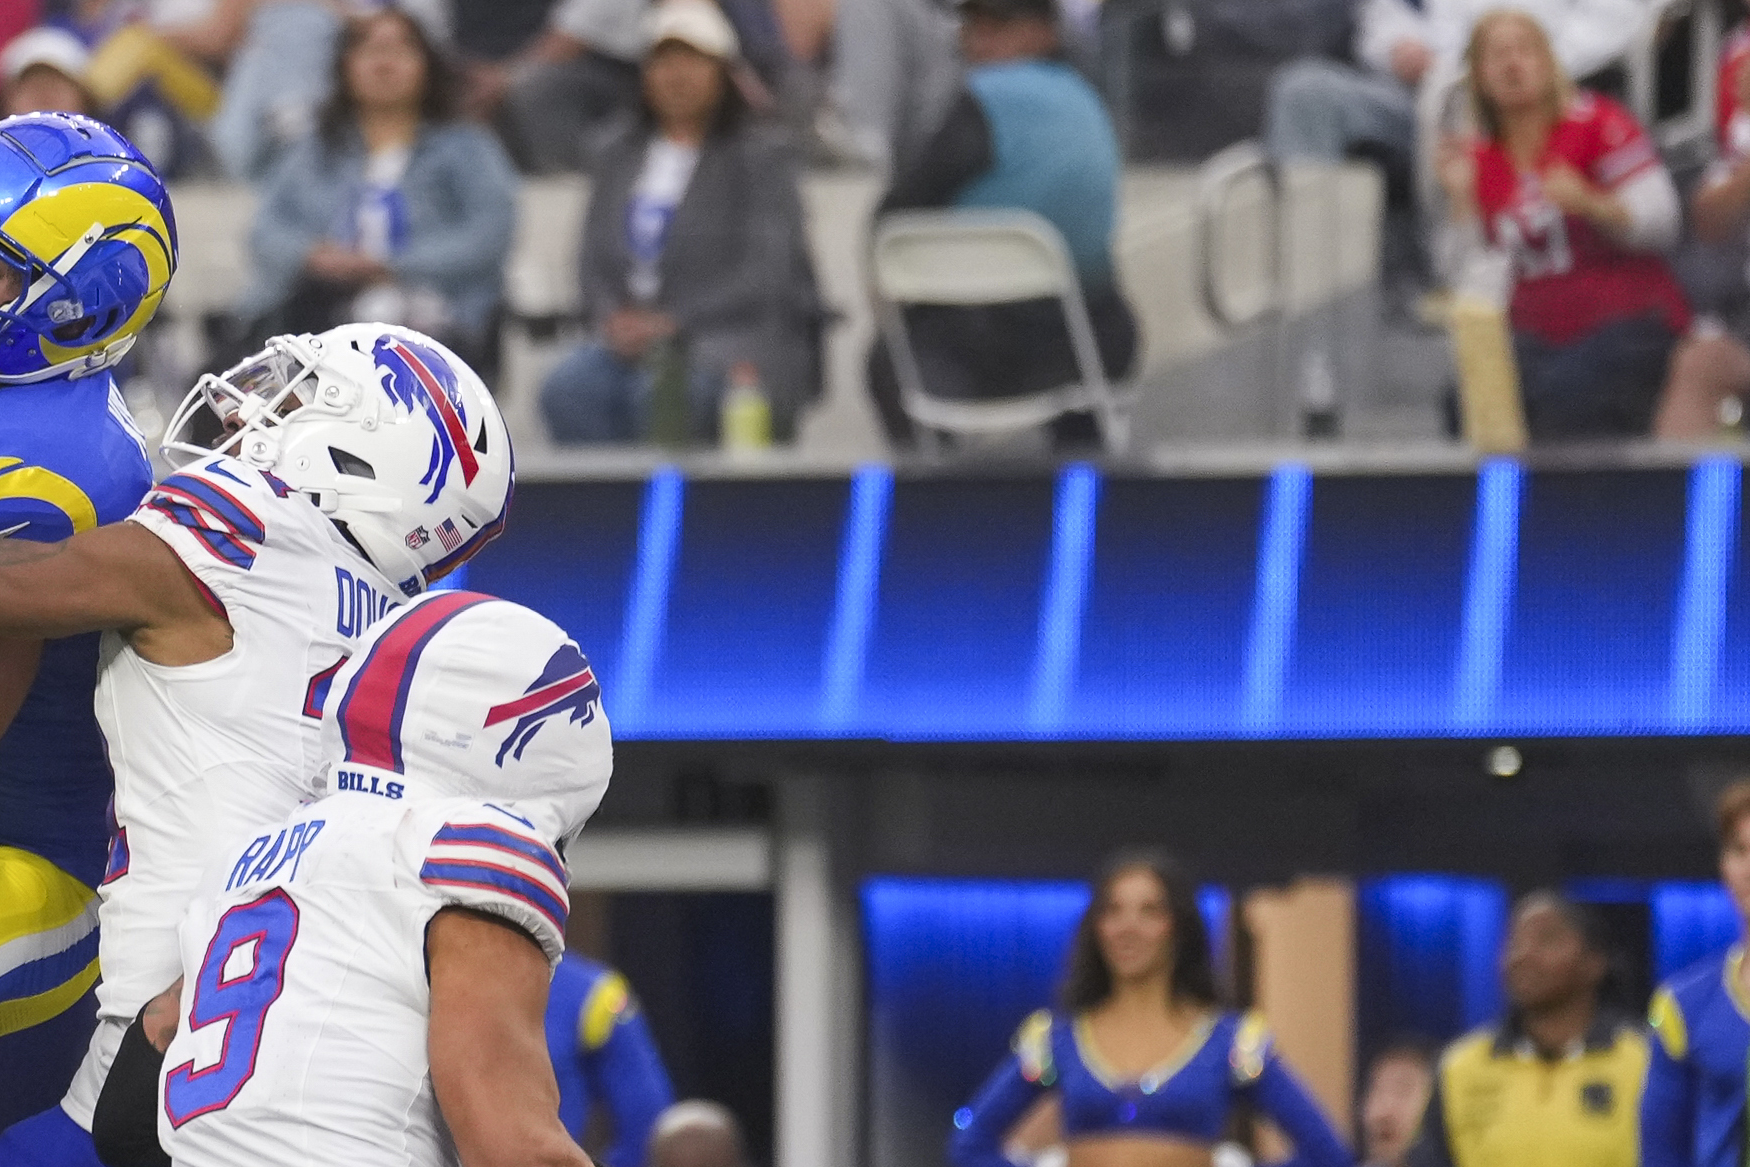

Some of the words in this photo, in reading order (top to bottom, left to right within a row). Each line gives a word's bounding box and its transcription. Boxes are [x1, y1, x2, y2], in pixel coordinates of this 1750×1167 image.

[337, 770, 405, 800] BILLS
[225, 819, 326, 892] RAPP
[164, 885, 301, 1132] 9
